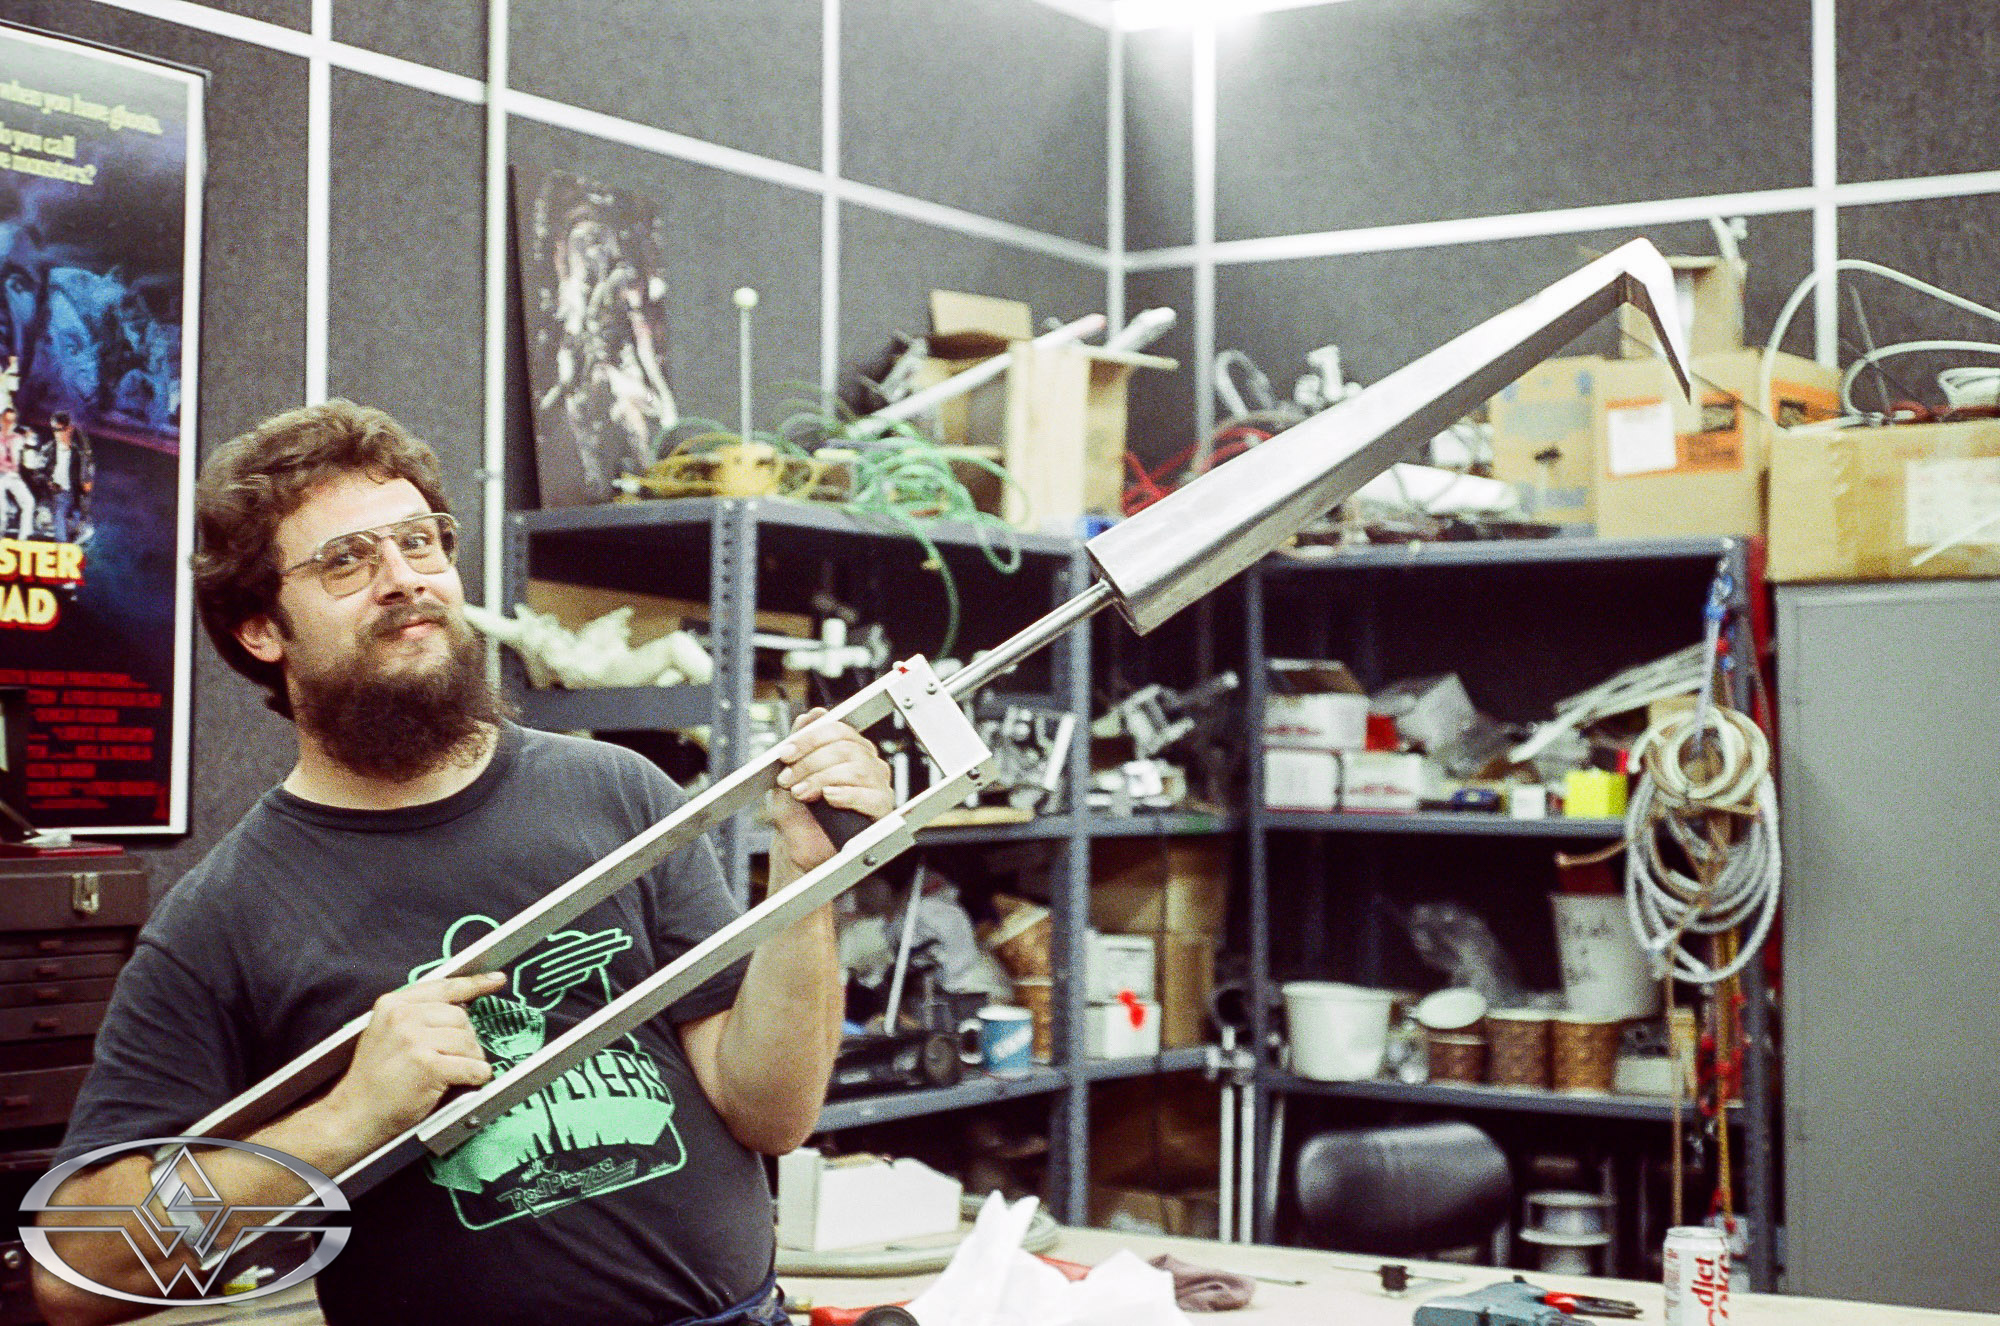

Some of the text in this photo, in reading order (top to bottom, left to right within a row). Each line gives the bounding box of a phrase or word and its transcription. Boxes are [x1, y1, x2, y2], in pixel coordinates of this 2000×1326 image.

[40, 92, 72, 114] you
[71, 93, 109, 123] have
[11, 129, 43, 152] you
[43, 134, 77, 160] call
[12, 153, 98, 186] monsters?
[0, 584, 60, 627] AD
[545, 1049, 672, 1105] LYERS
[1690, 1257, 1714, 1307] diet
